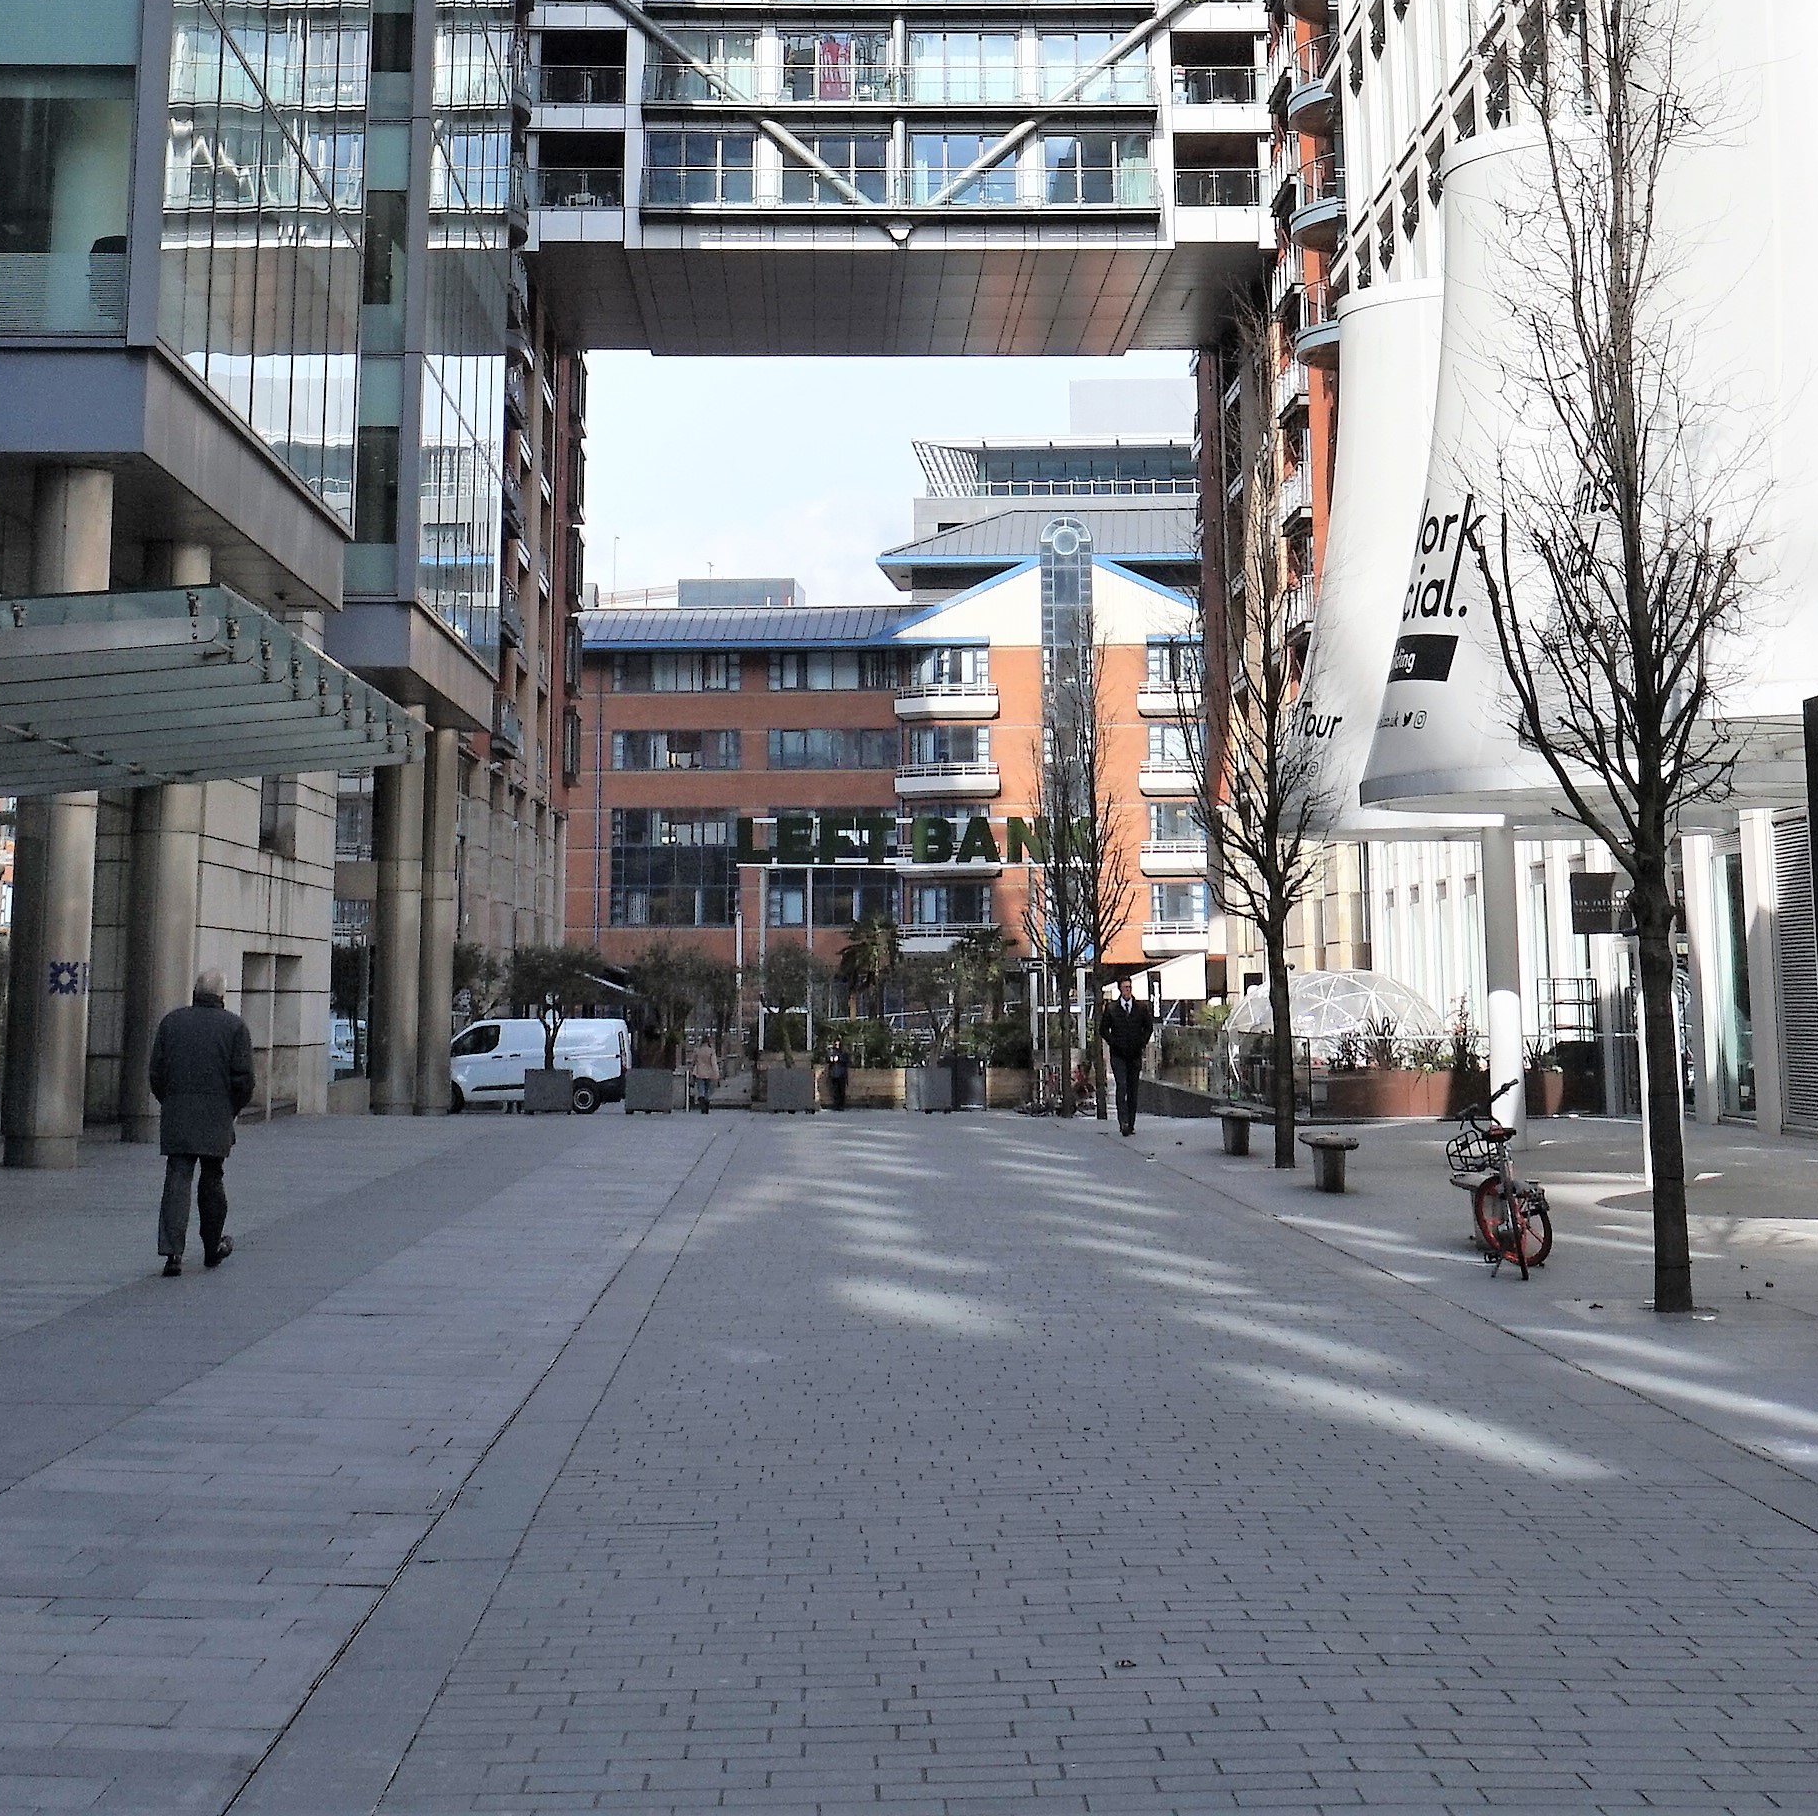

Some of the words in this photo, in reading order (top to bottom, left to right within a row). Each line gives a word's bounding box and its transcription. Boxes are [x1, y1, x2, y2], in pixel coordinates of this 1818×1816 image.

[1414, 493, 1487, 558] ork
[1297, 701, 1343, 739] Tour
[737, 817, 896, 864] LEFT
